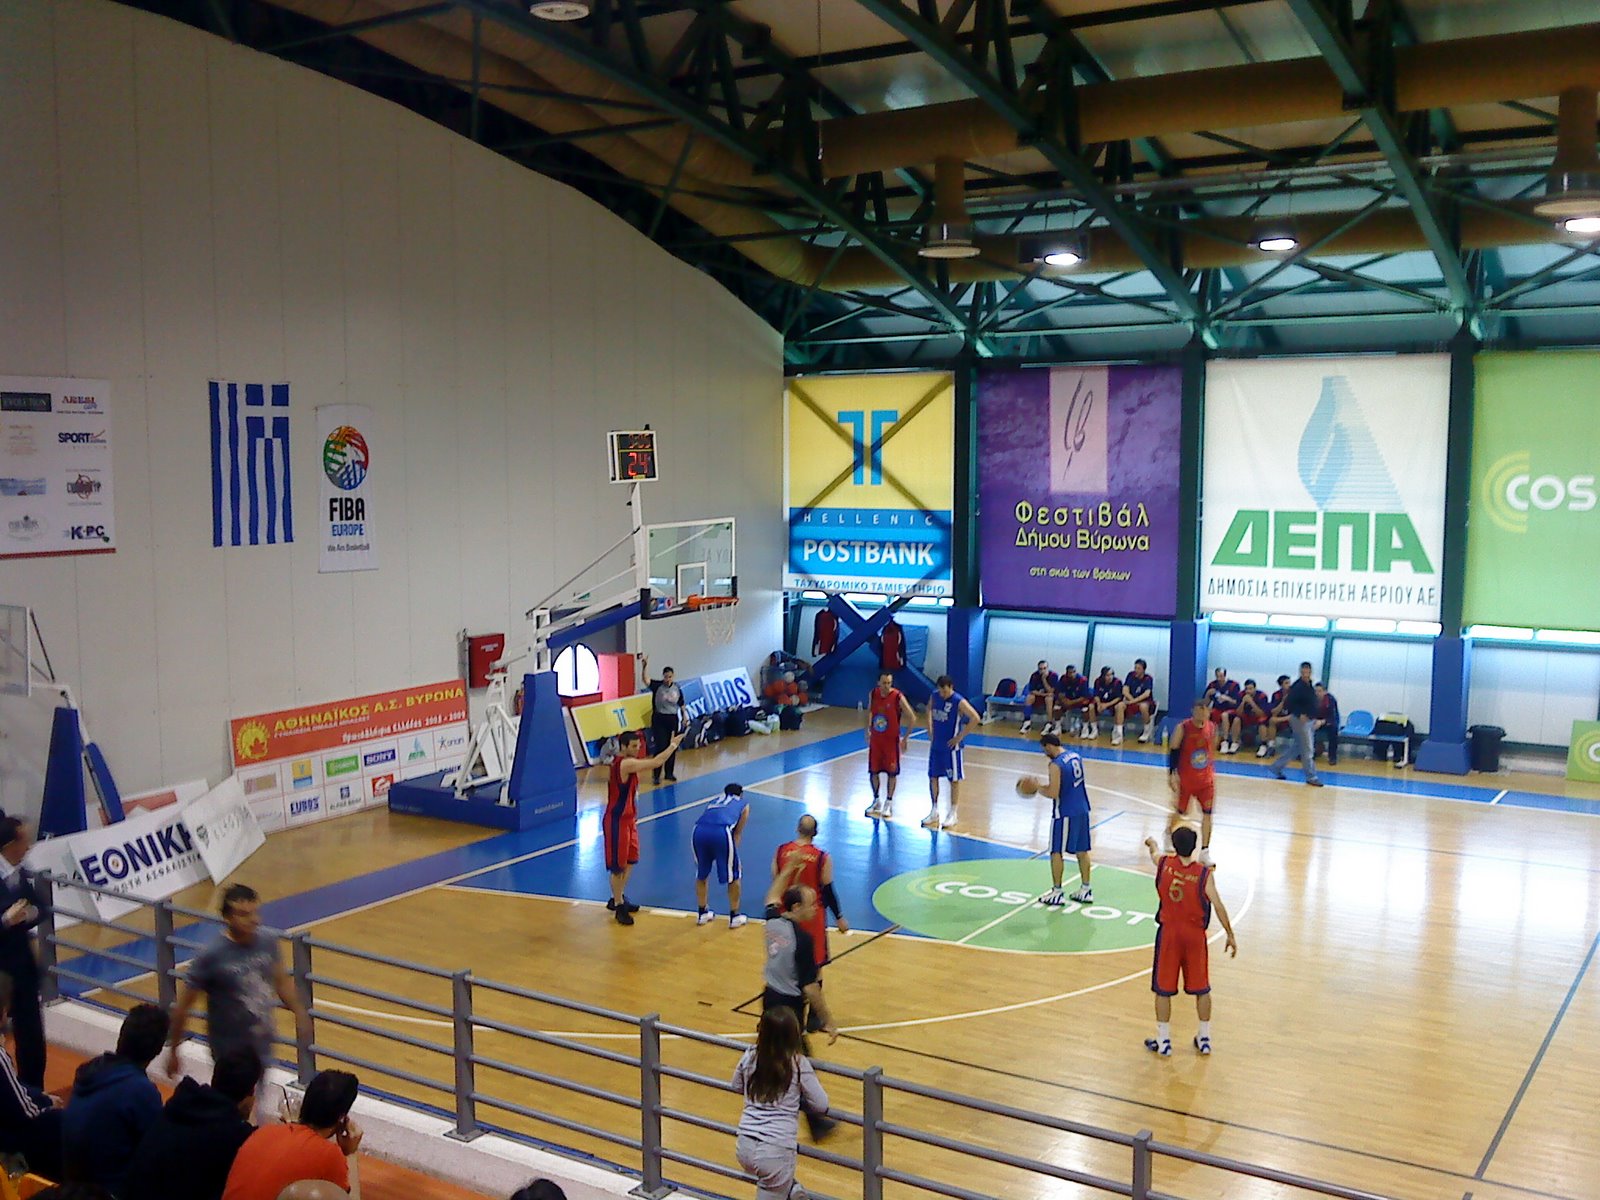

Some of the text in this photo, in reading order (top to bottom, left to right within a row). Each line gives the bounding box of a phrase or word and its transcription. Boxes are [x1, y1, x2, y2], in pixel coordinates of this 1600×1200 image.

[58, 432, 90, 443] SPORT
[329, 497, 365, 522] FIBA
[803, 512, 933, 527] HELLENIC
[1015, 500, 1150, 527] Φεστιβάλ
[332, 523, 365, 536] EUROPE
[1015, 527, 1150, 554] Δήμου Βύρωνα
[1211, 509, 1435, 575] ΔΕΠΑ
[803, 539, 934, 566] POSTBANK
[794, 578, 945, 595] ΤΑΧΥΔΡΟΜΙΚΟ ΤΑΜΙΕΥΤΗΡΙΟ
[1207, 577, 1268, 598] ΔΗΜΟΣΙΑ
[1273, 580, 1356, 603] ΕΠΙΧΕΙΡΗΣΗ
[1360, 584, 1412, 605] ΑΕΡΙΟΥ
[273, 704, 370, 732] ΑΘΗΝΑΪΚΟΣ
[406, 687, 464, 707] ΒΥΡΩΝΑ
[366, 751, 392, 765] SONY
[1071, 758, 1082, 779] 8
